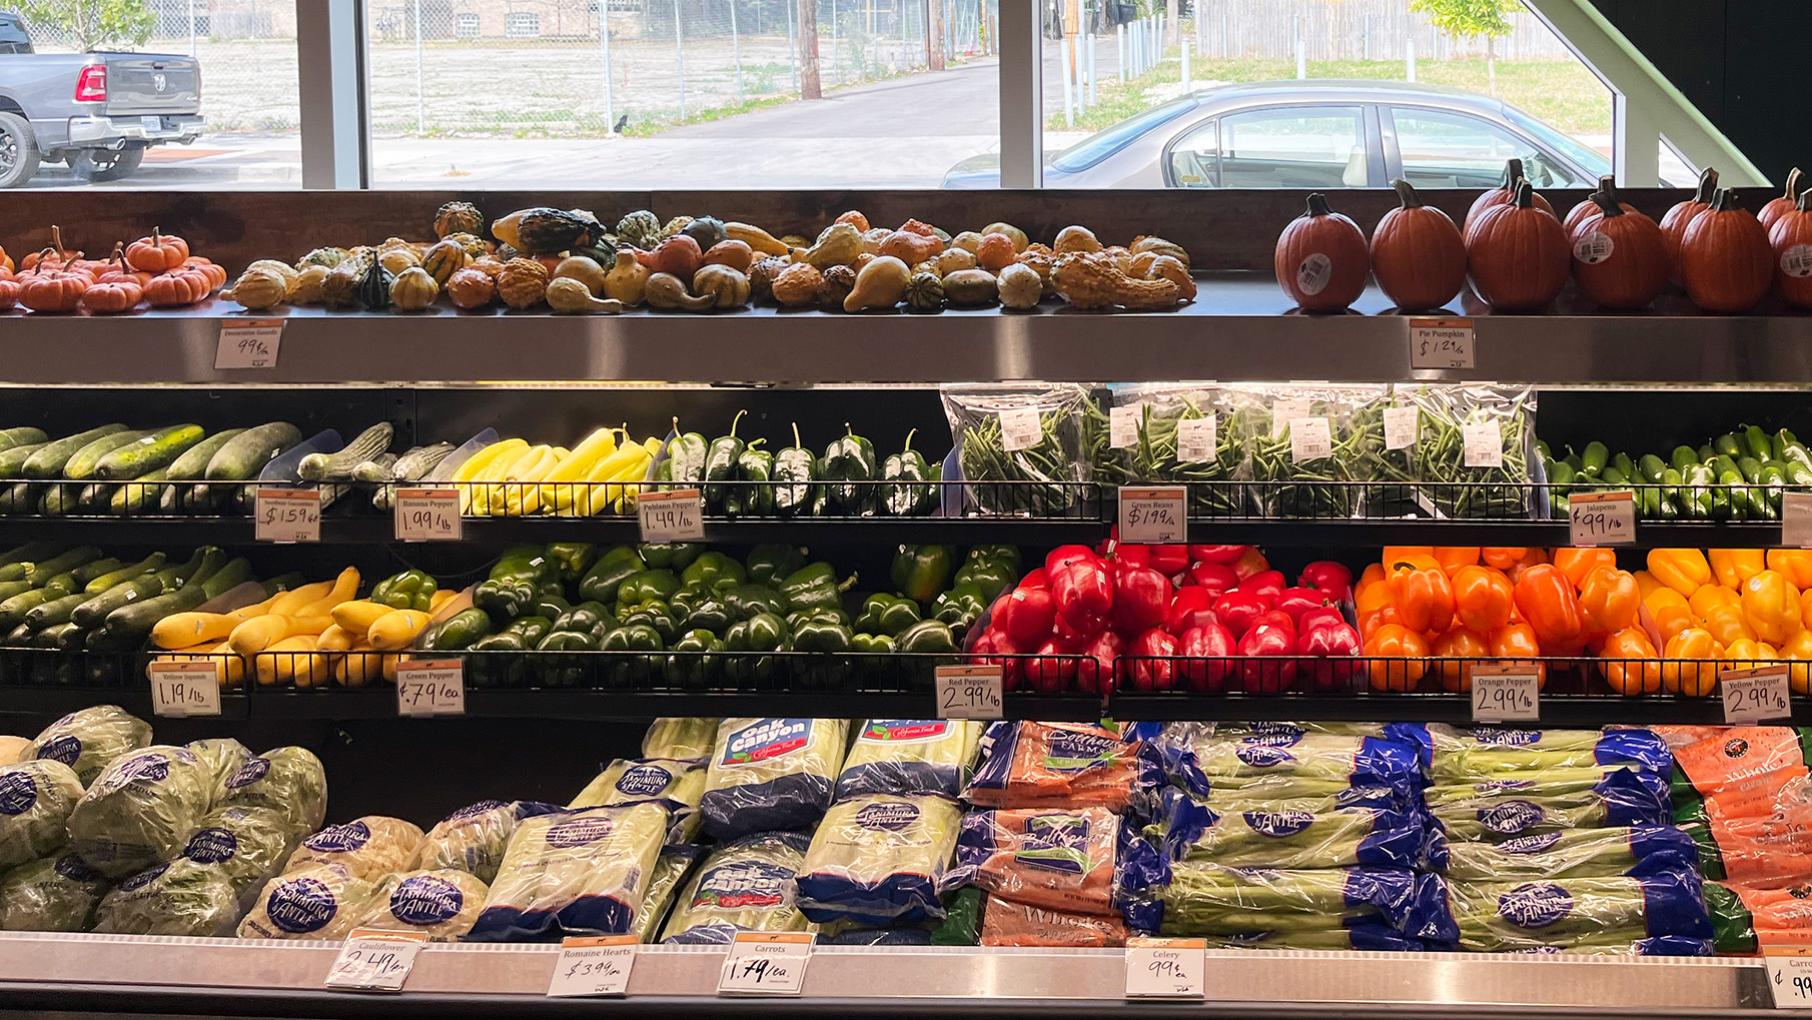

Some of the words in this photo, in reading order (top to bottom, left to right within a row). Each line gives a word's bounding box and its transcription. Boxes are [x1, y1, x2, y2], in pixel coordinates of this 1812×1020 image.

[1420, 331, 1431, 339] Pie
[1433, 331, 1465, 340] Pumpkin
[430, 501, 455, 509] Pepper
[672, 502, 696, 510] Pepper
[428, 672, 454, 681] Pepper
[965, 678, 990, 687] Pepper
[1478, 679, 1504, 687] Orange
[1506, 679, 1531, 688] Pepper
[1728, 681, 1752, 689] Yellow
[1753, 678, 1780, 688] Pepper
[731, 723, 806, 753] Canyon
[622, 772, 669, 787] TANIMURA
[625, 781, 659, 795] ANTLE
[1257, 814, 1300, 831] ANTLE
[397, 898, 445, 918] ANTLE
[270, 901, 314, 927] ANTLE
[1519, 903, 1560, 927] ANTLE
[359, 943, 406, 952] Cauliflower
[755, 945, 786, 953] Carrots
[564, 950, 601, 959] Romaine
[602, 948, 632, 957] Hearts
[1153, 950, 1180, 960] Celery
